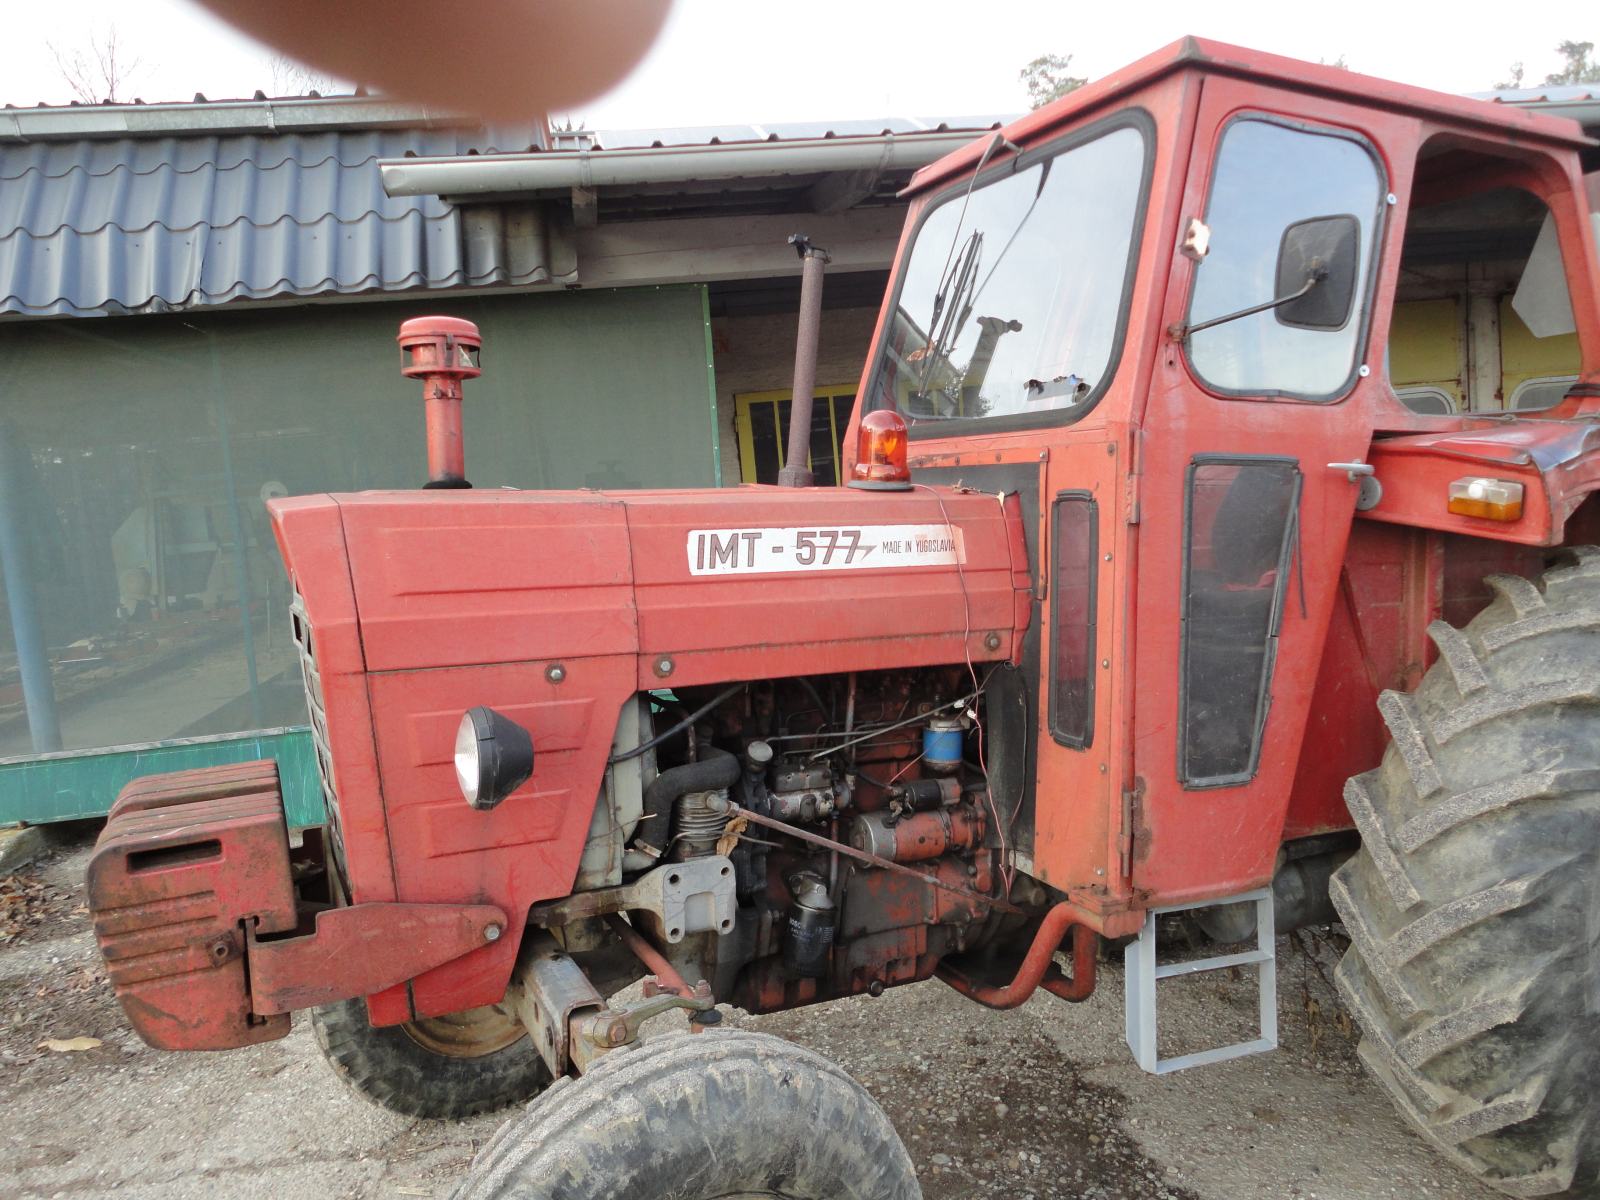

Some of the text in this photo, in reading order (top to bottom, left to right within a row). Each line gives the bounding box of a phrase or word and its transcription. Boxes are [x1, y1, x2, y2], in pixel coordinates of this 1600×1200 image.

[696, 532, 762, 570] IMT
[795, 530, 861, 566] 577
[882, 538, 956, 554] MADE IN YUGOSLAVIA
